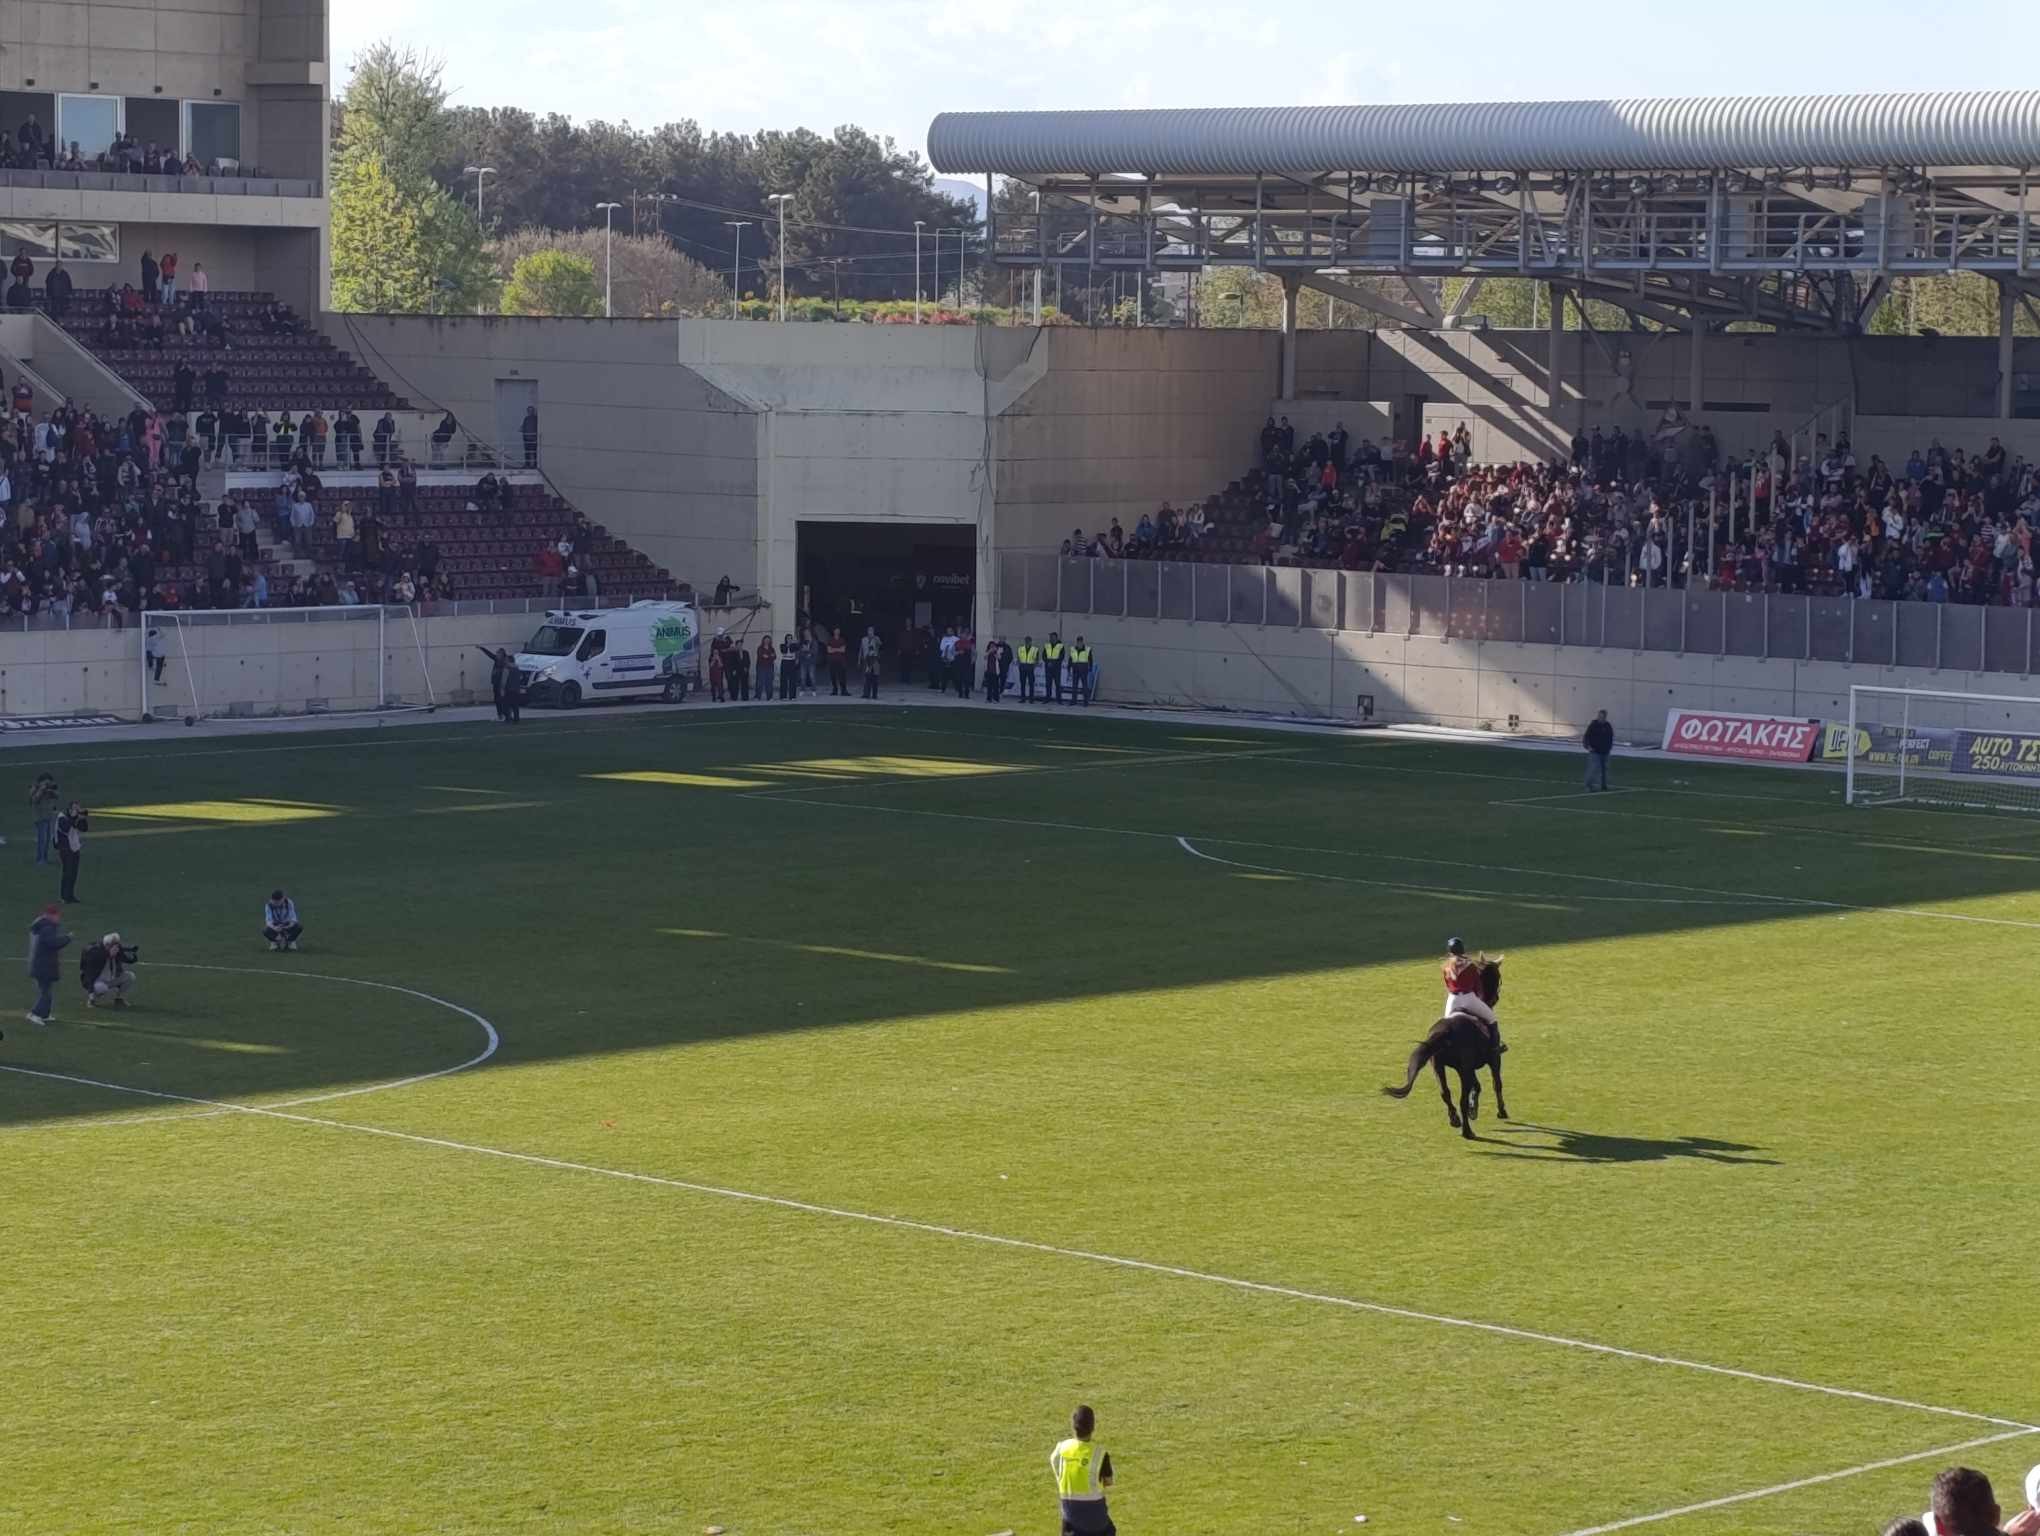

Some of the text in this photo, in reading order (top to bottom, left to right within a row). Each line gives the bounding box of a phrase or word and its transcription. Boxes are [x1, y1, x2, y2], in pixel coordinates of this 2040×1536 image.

[656, 625, 691, 638] ANIMUS
[1681, 719, 1810, 748] ΦΩΤΑΚΗΣ
[1970, 737, 2012, 756] AUTO
[1973, 756, 2000, 769] 250
